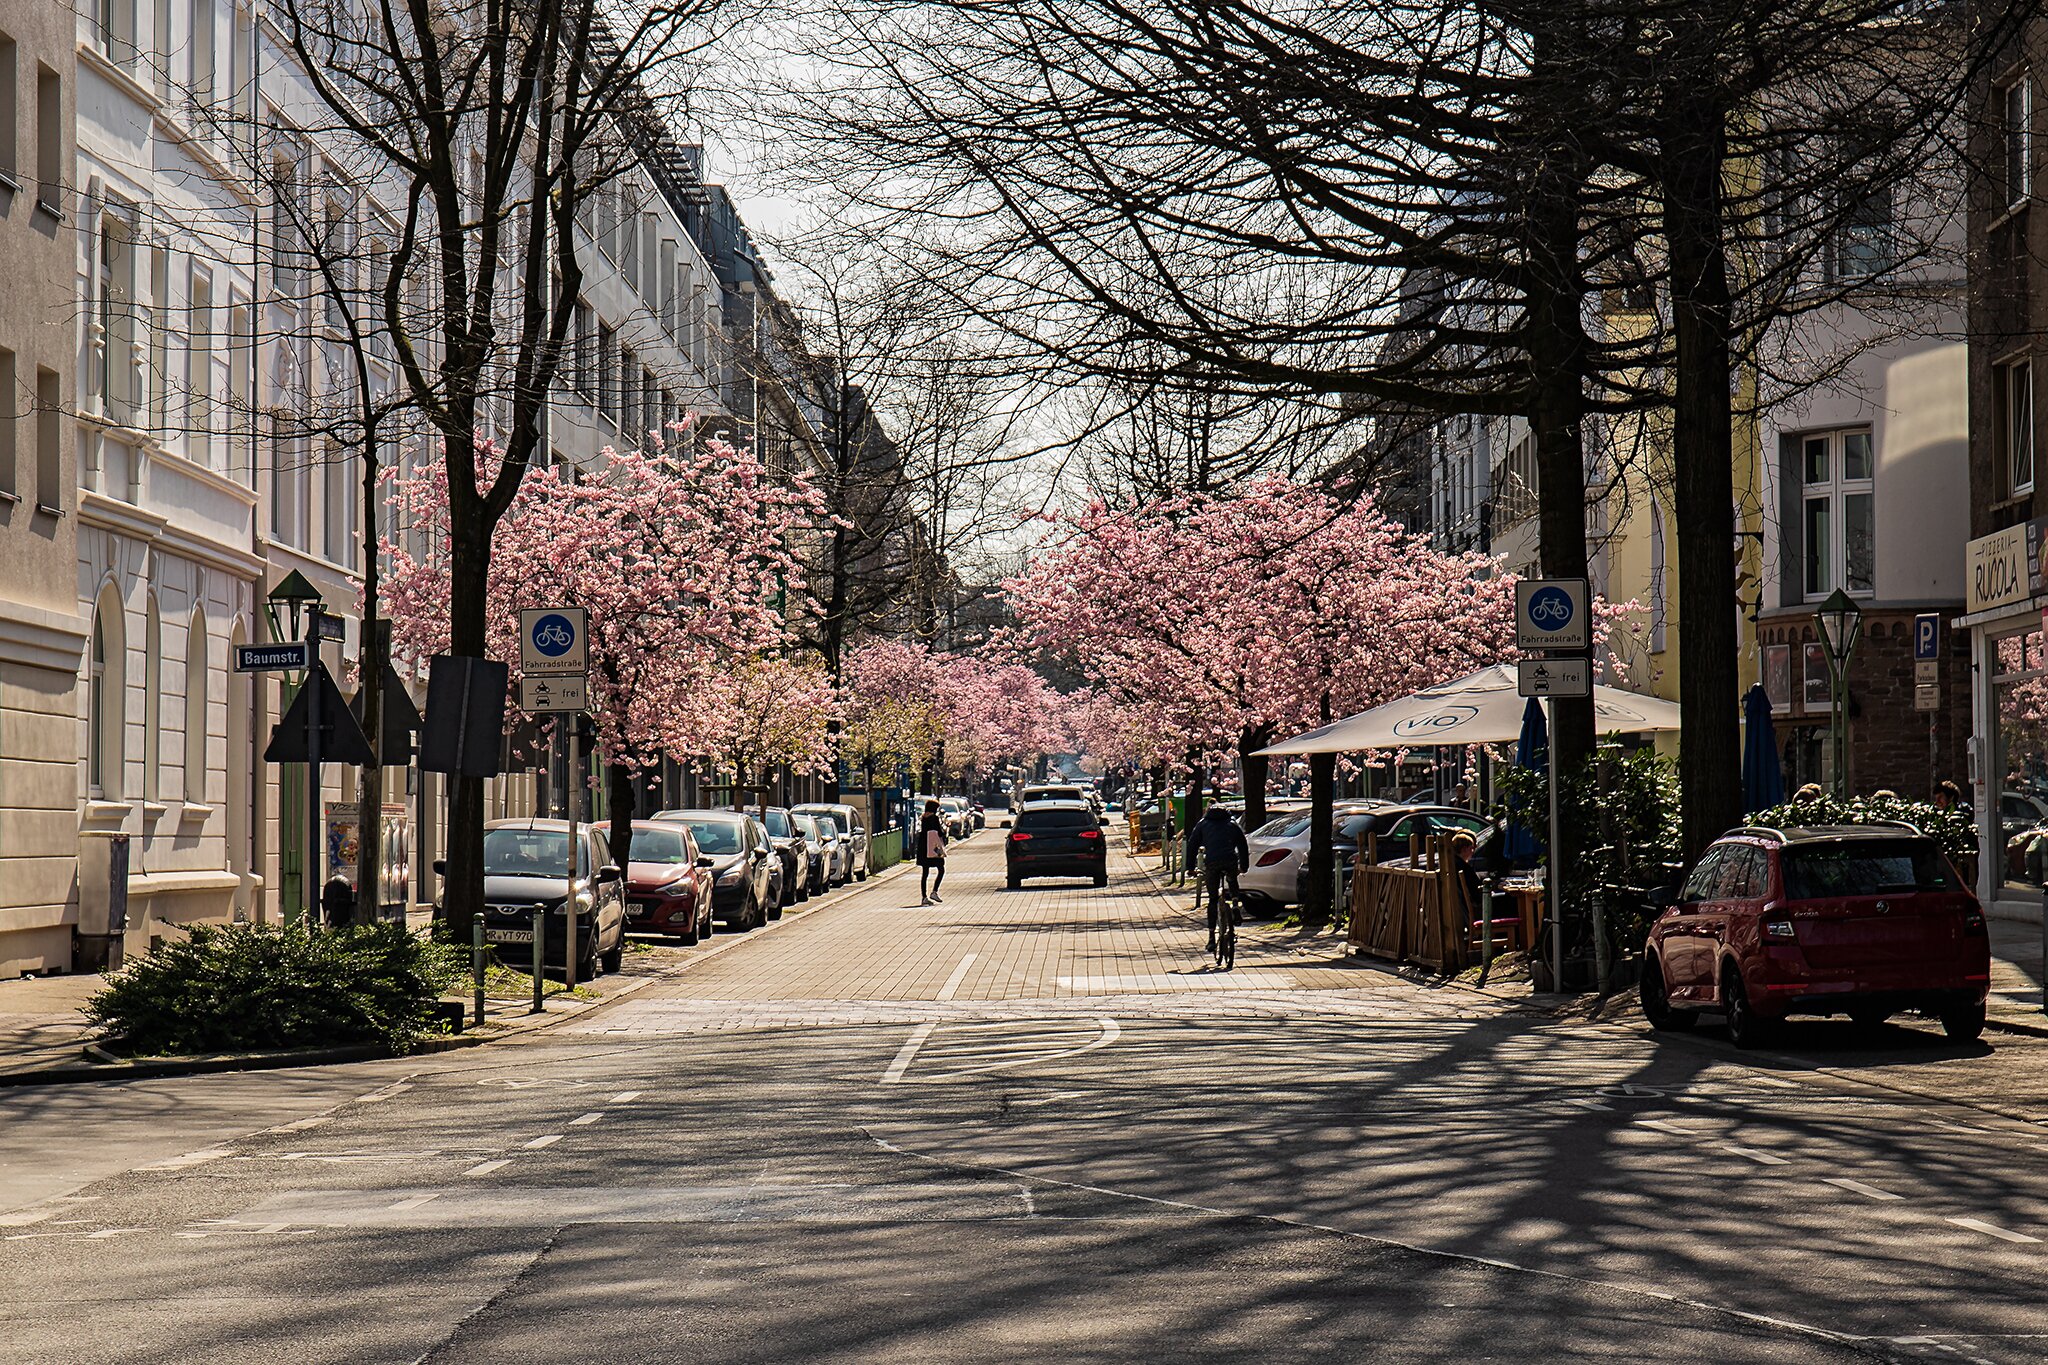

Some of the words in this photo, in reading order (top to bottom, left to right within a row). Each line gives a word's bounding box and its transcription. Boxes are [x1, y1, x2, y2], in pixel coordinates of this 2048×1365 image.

[1981, 535, 2012, 558] PIZZERIA
[1976, 553, 2019, 604] RUCOLA
[1521, 634, 1582, 644] Fahrradstraße
[1920, 621, 1933, 654] P
[244, 651, 301, 665] Baumstr.
[525, 659, 582, 669] Fahrradstraße
[1562, 672, 1580, 682] frei
[562, 688, 579, 698] frei
[503, 931, 514, 940] YT
[516, 931, 532, 941] 970
